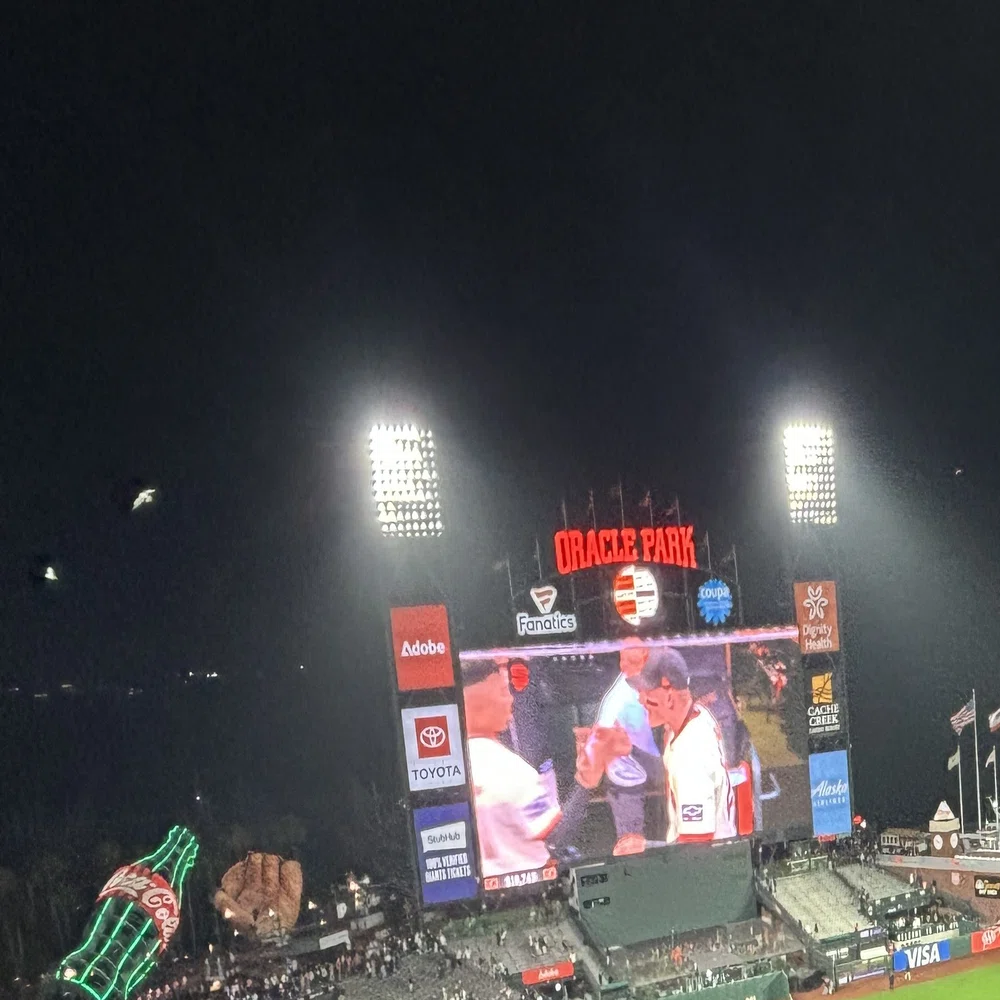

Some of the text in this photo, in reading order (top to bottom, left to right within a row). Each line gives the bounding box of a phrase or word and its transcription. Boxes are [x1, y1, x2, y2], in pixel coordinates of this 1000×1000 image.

[554, 525, 698, 575] ORACLE PARK
[700, 587, 730, 601] coupa
[519, 615, 575, 632] Fanatics
[803, 623, 832, 639] Dignity
[401, 639, 446, 657] Adobe
[805, 638, 833, 651] Health
[807, 703, 840, 717] CACHE
[809, 714, 839, 727] CREEK
[411, 765, 462, 781] TOYOTA
[811, 779, 849, 799] Alaska
[427, 831, 461, 845] StubHub
[904, 943, 941, 969] VISA
